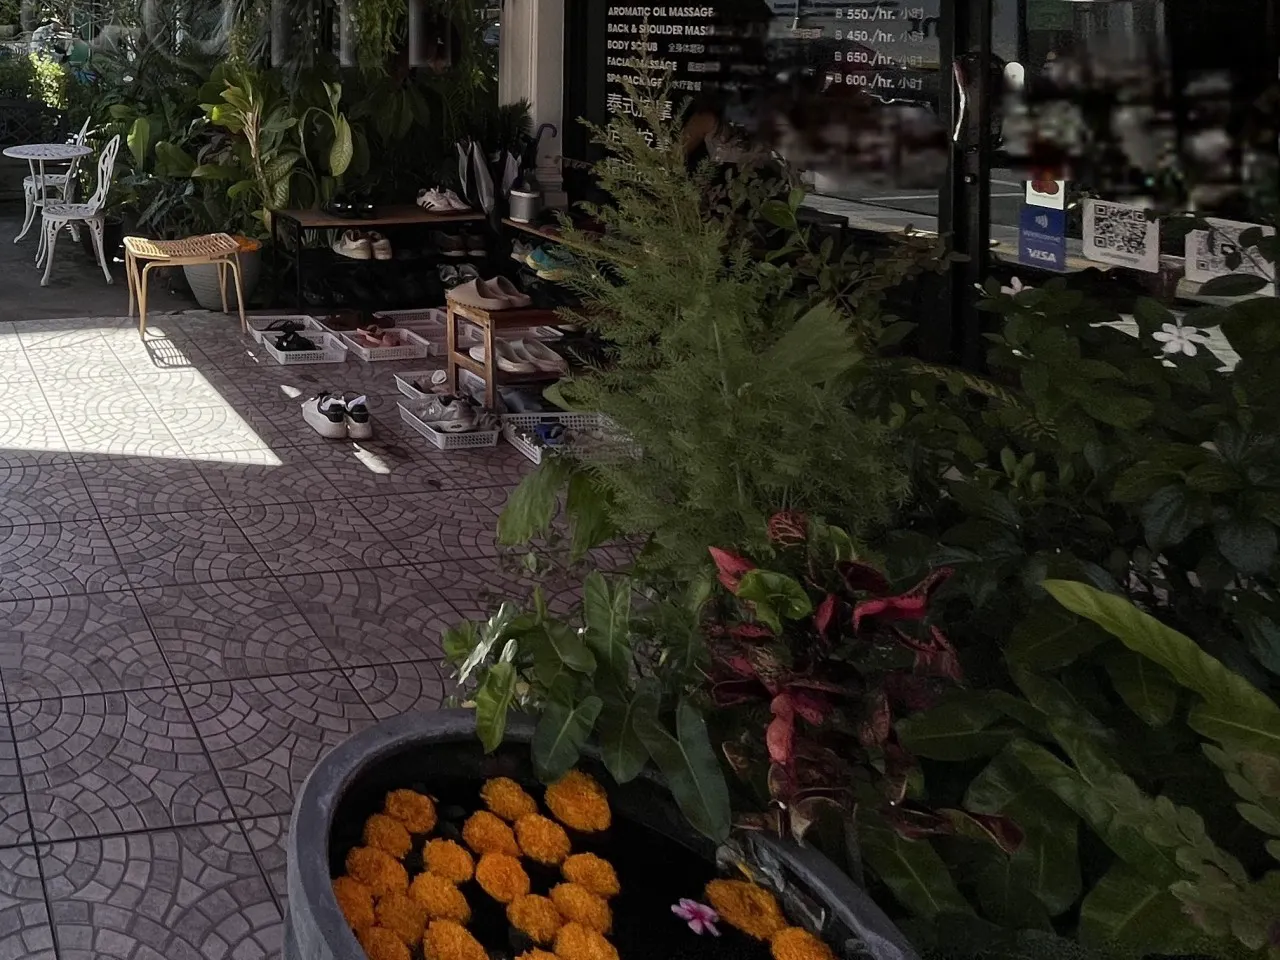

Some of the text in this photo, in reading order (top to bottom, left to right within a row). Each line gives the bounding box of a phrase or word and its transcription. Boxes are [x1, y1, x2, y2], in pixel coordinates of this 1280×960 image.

[608, 7, 714, 17] AROMATIC OIL MASSAGE
[608, 23, 629, 33] BACK
[631, 24, 637, 33] &
[607, 40, 658, 51] BODY SCUB
[607, 56, 631, 66] FACIA
[1026, 247, 1057, 263] VISA
